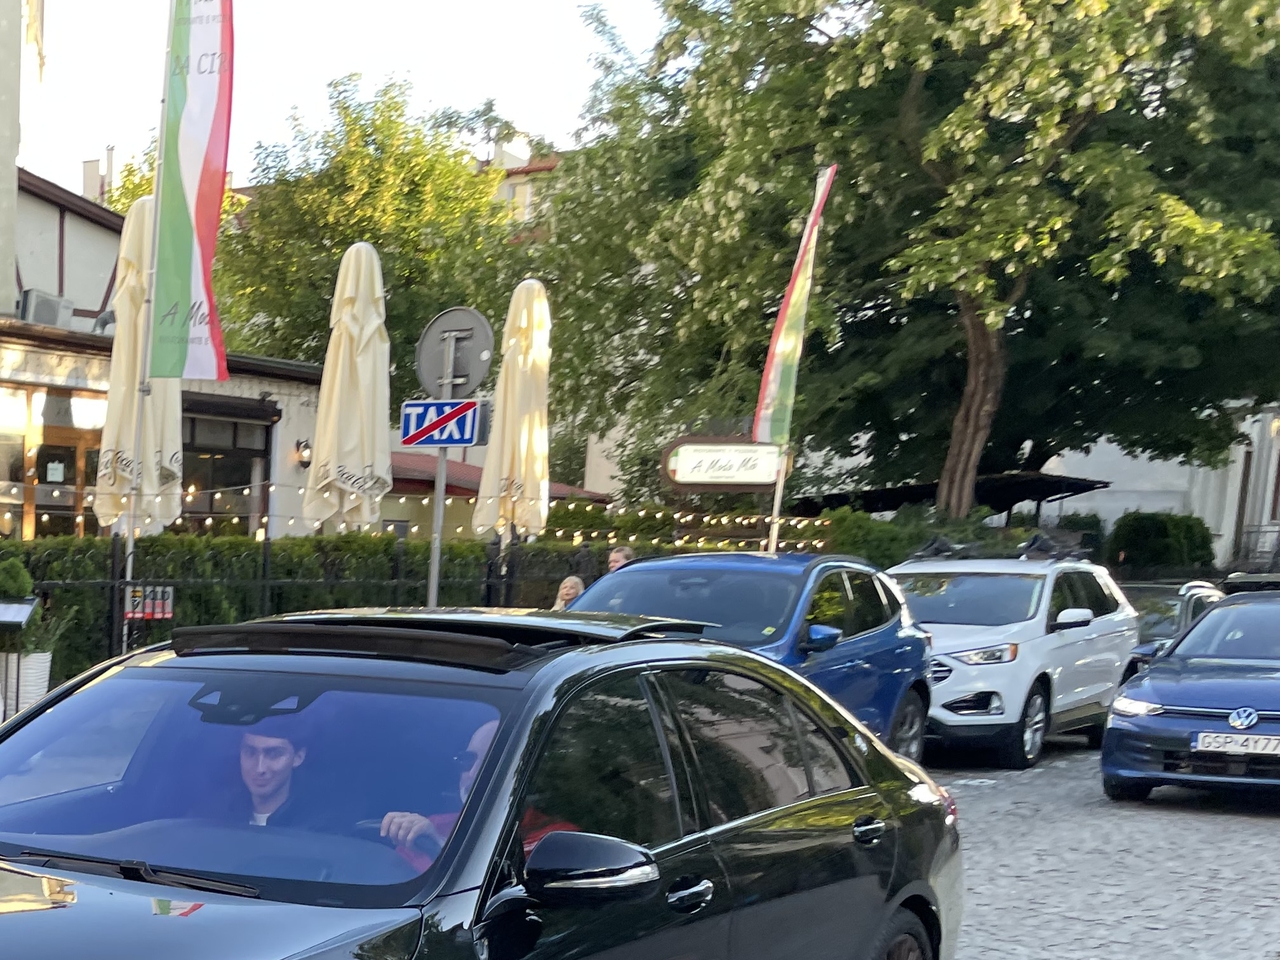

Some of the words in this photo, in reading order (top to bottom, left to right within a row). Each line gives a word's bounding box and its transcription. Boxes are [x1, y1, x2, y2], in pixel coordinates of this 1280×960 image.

[160, 300, 179, 326] A
[404, 405, 474, 440] TAXI
[1201, 734, 1234, 749] GSP
